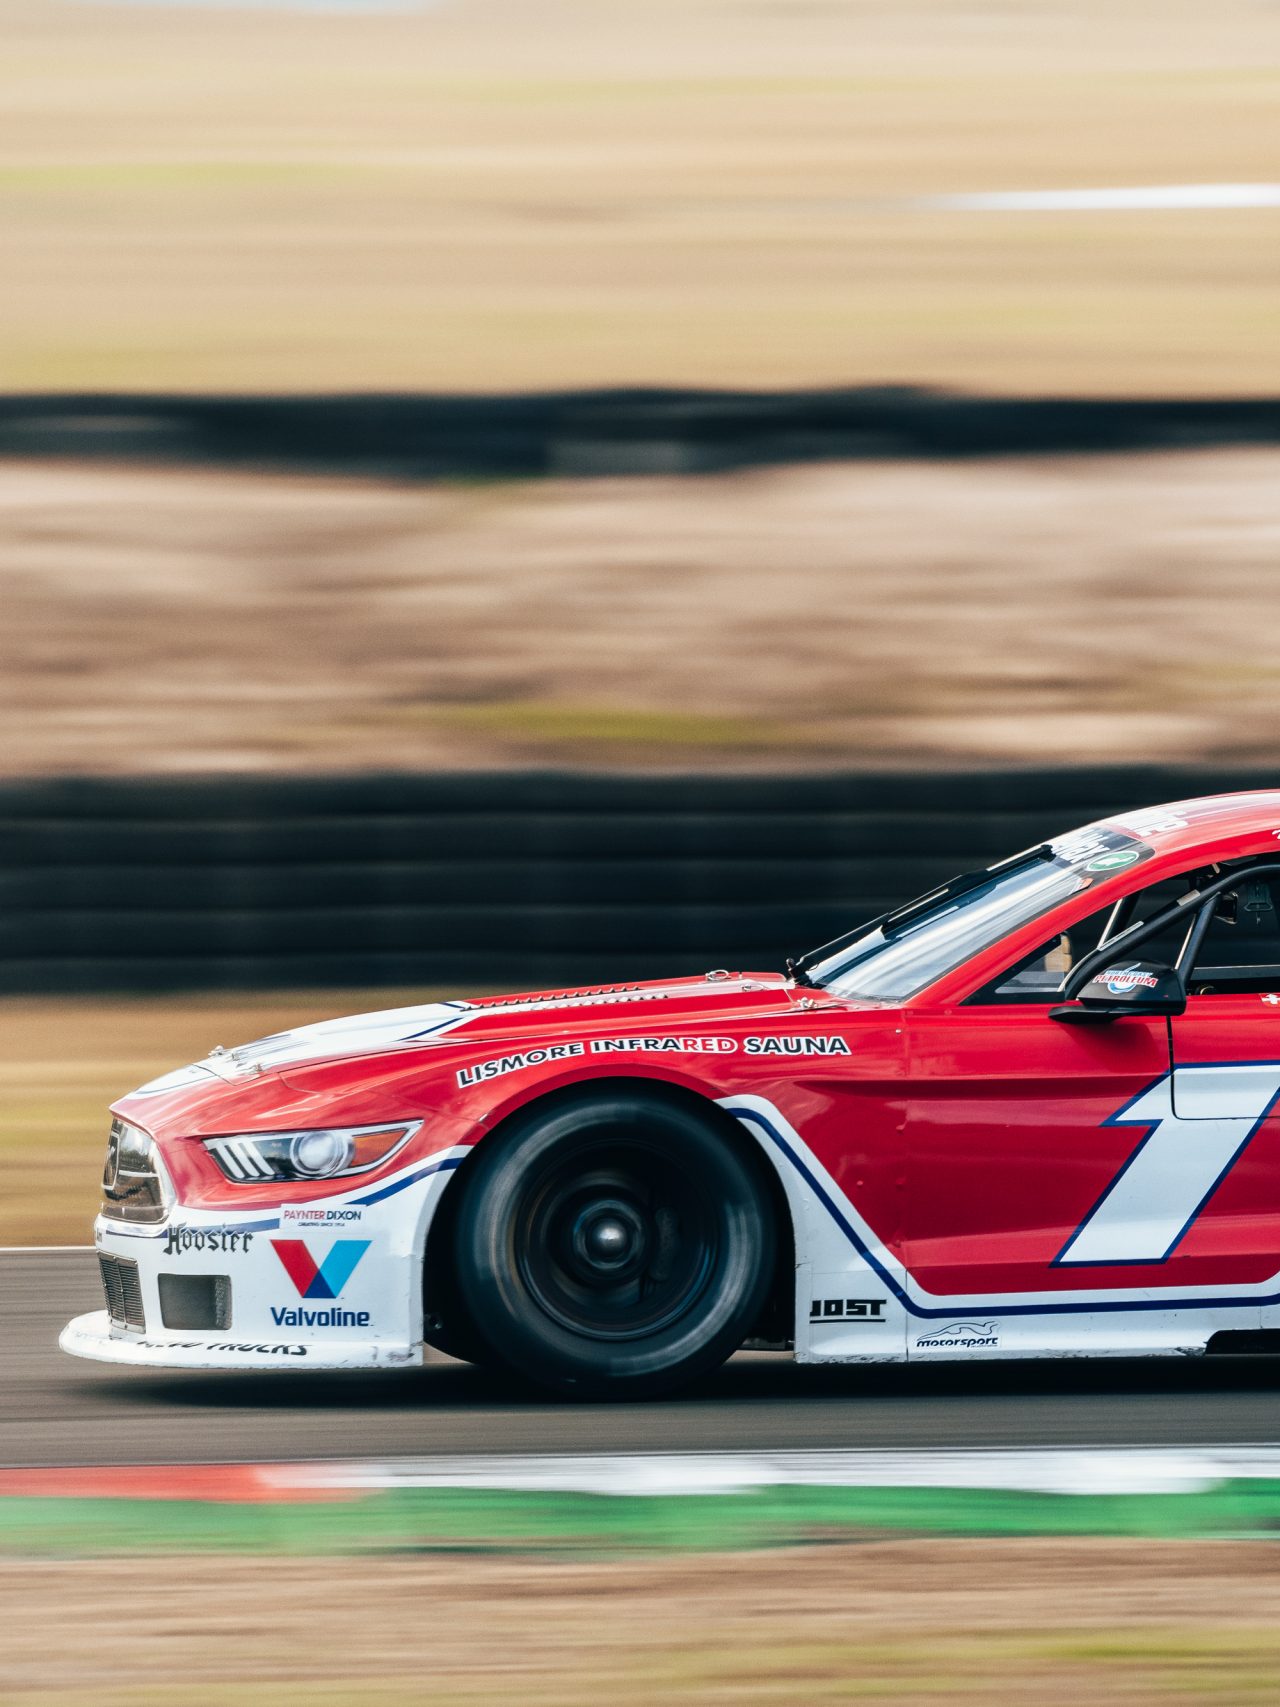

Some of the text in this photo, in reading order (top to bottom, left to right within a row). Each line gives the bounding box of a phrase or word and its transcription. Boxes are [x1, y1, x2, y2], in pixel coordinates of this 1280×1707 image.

[459, 1038, 848, 1086] LISMORE INFRARED SAUNA
[284, 1210, 362, 1220] PAYNTER DIXON
[163, 1222, 254, 1255] Hoosier
[270, 1306, 371, 1327] Valvoline
[809, 1299, 887, 1317] JOST
[916, 1337, 999, 1348] motorsport
